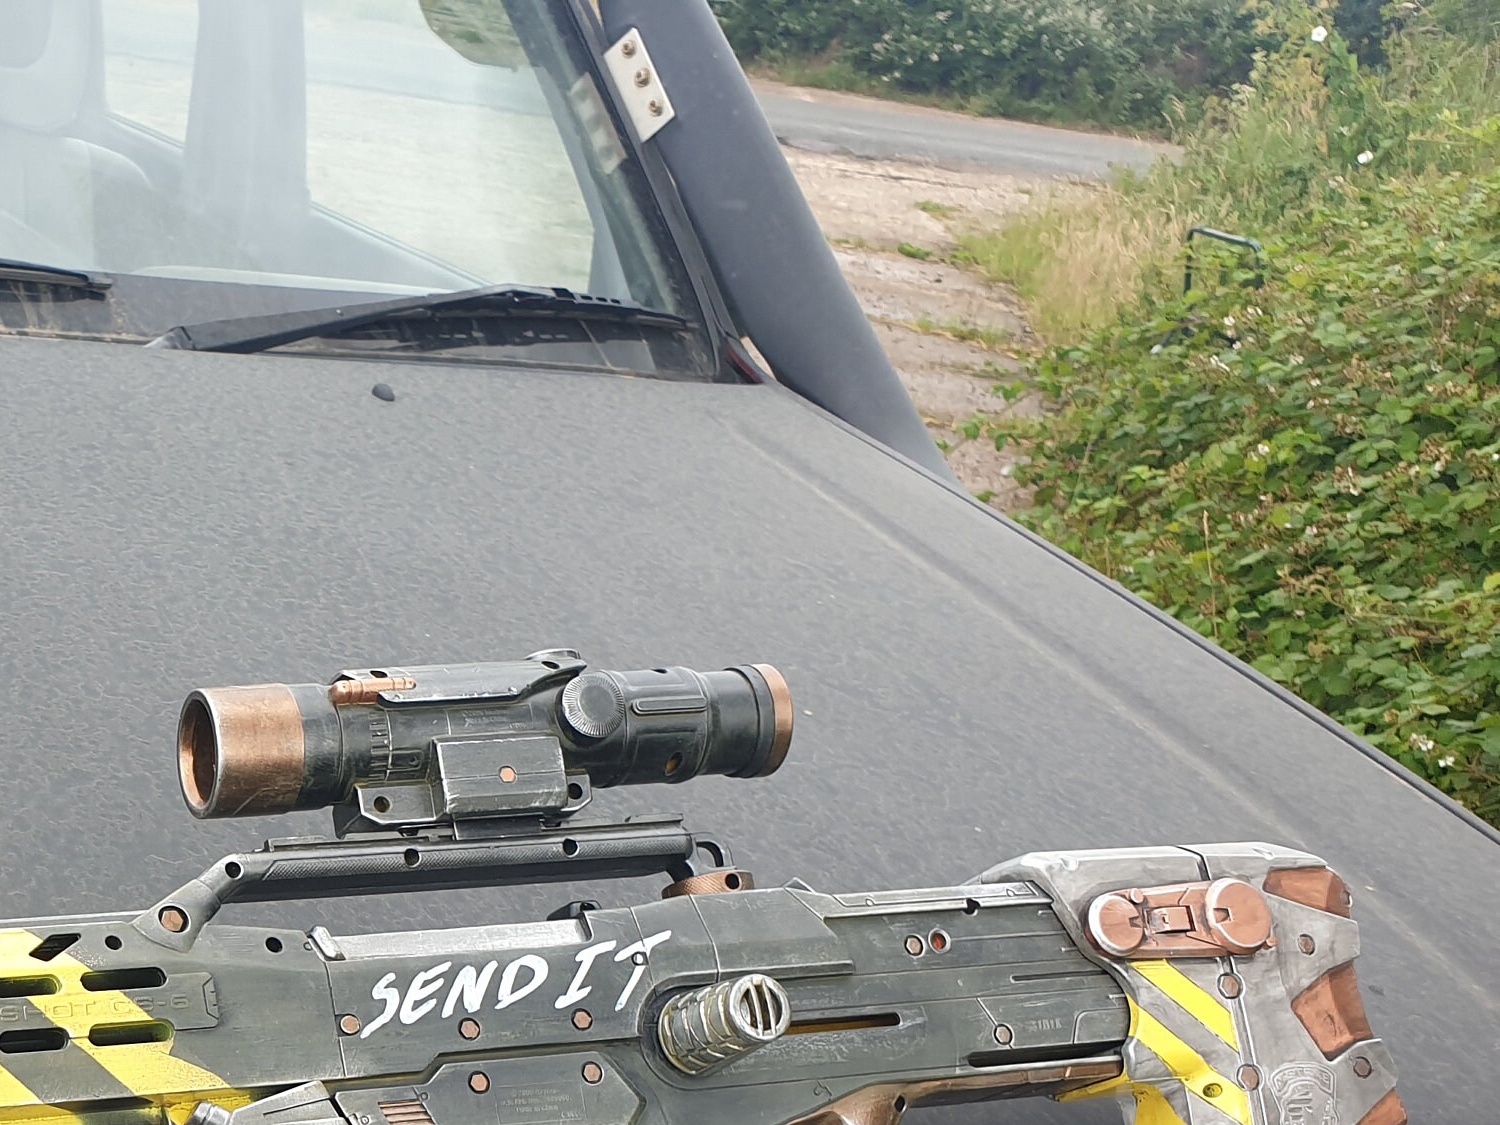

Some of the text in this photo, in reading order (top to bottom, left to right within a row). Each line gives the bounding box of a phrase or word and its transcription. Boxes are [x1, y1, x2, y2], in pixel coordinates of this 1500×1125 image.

[109, 993, 190, 1015] CS-6
[360, 930, 672, 1039] SEND IT
